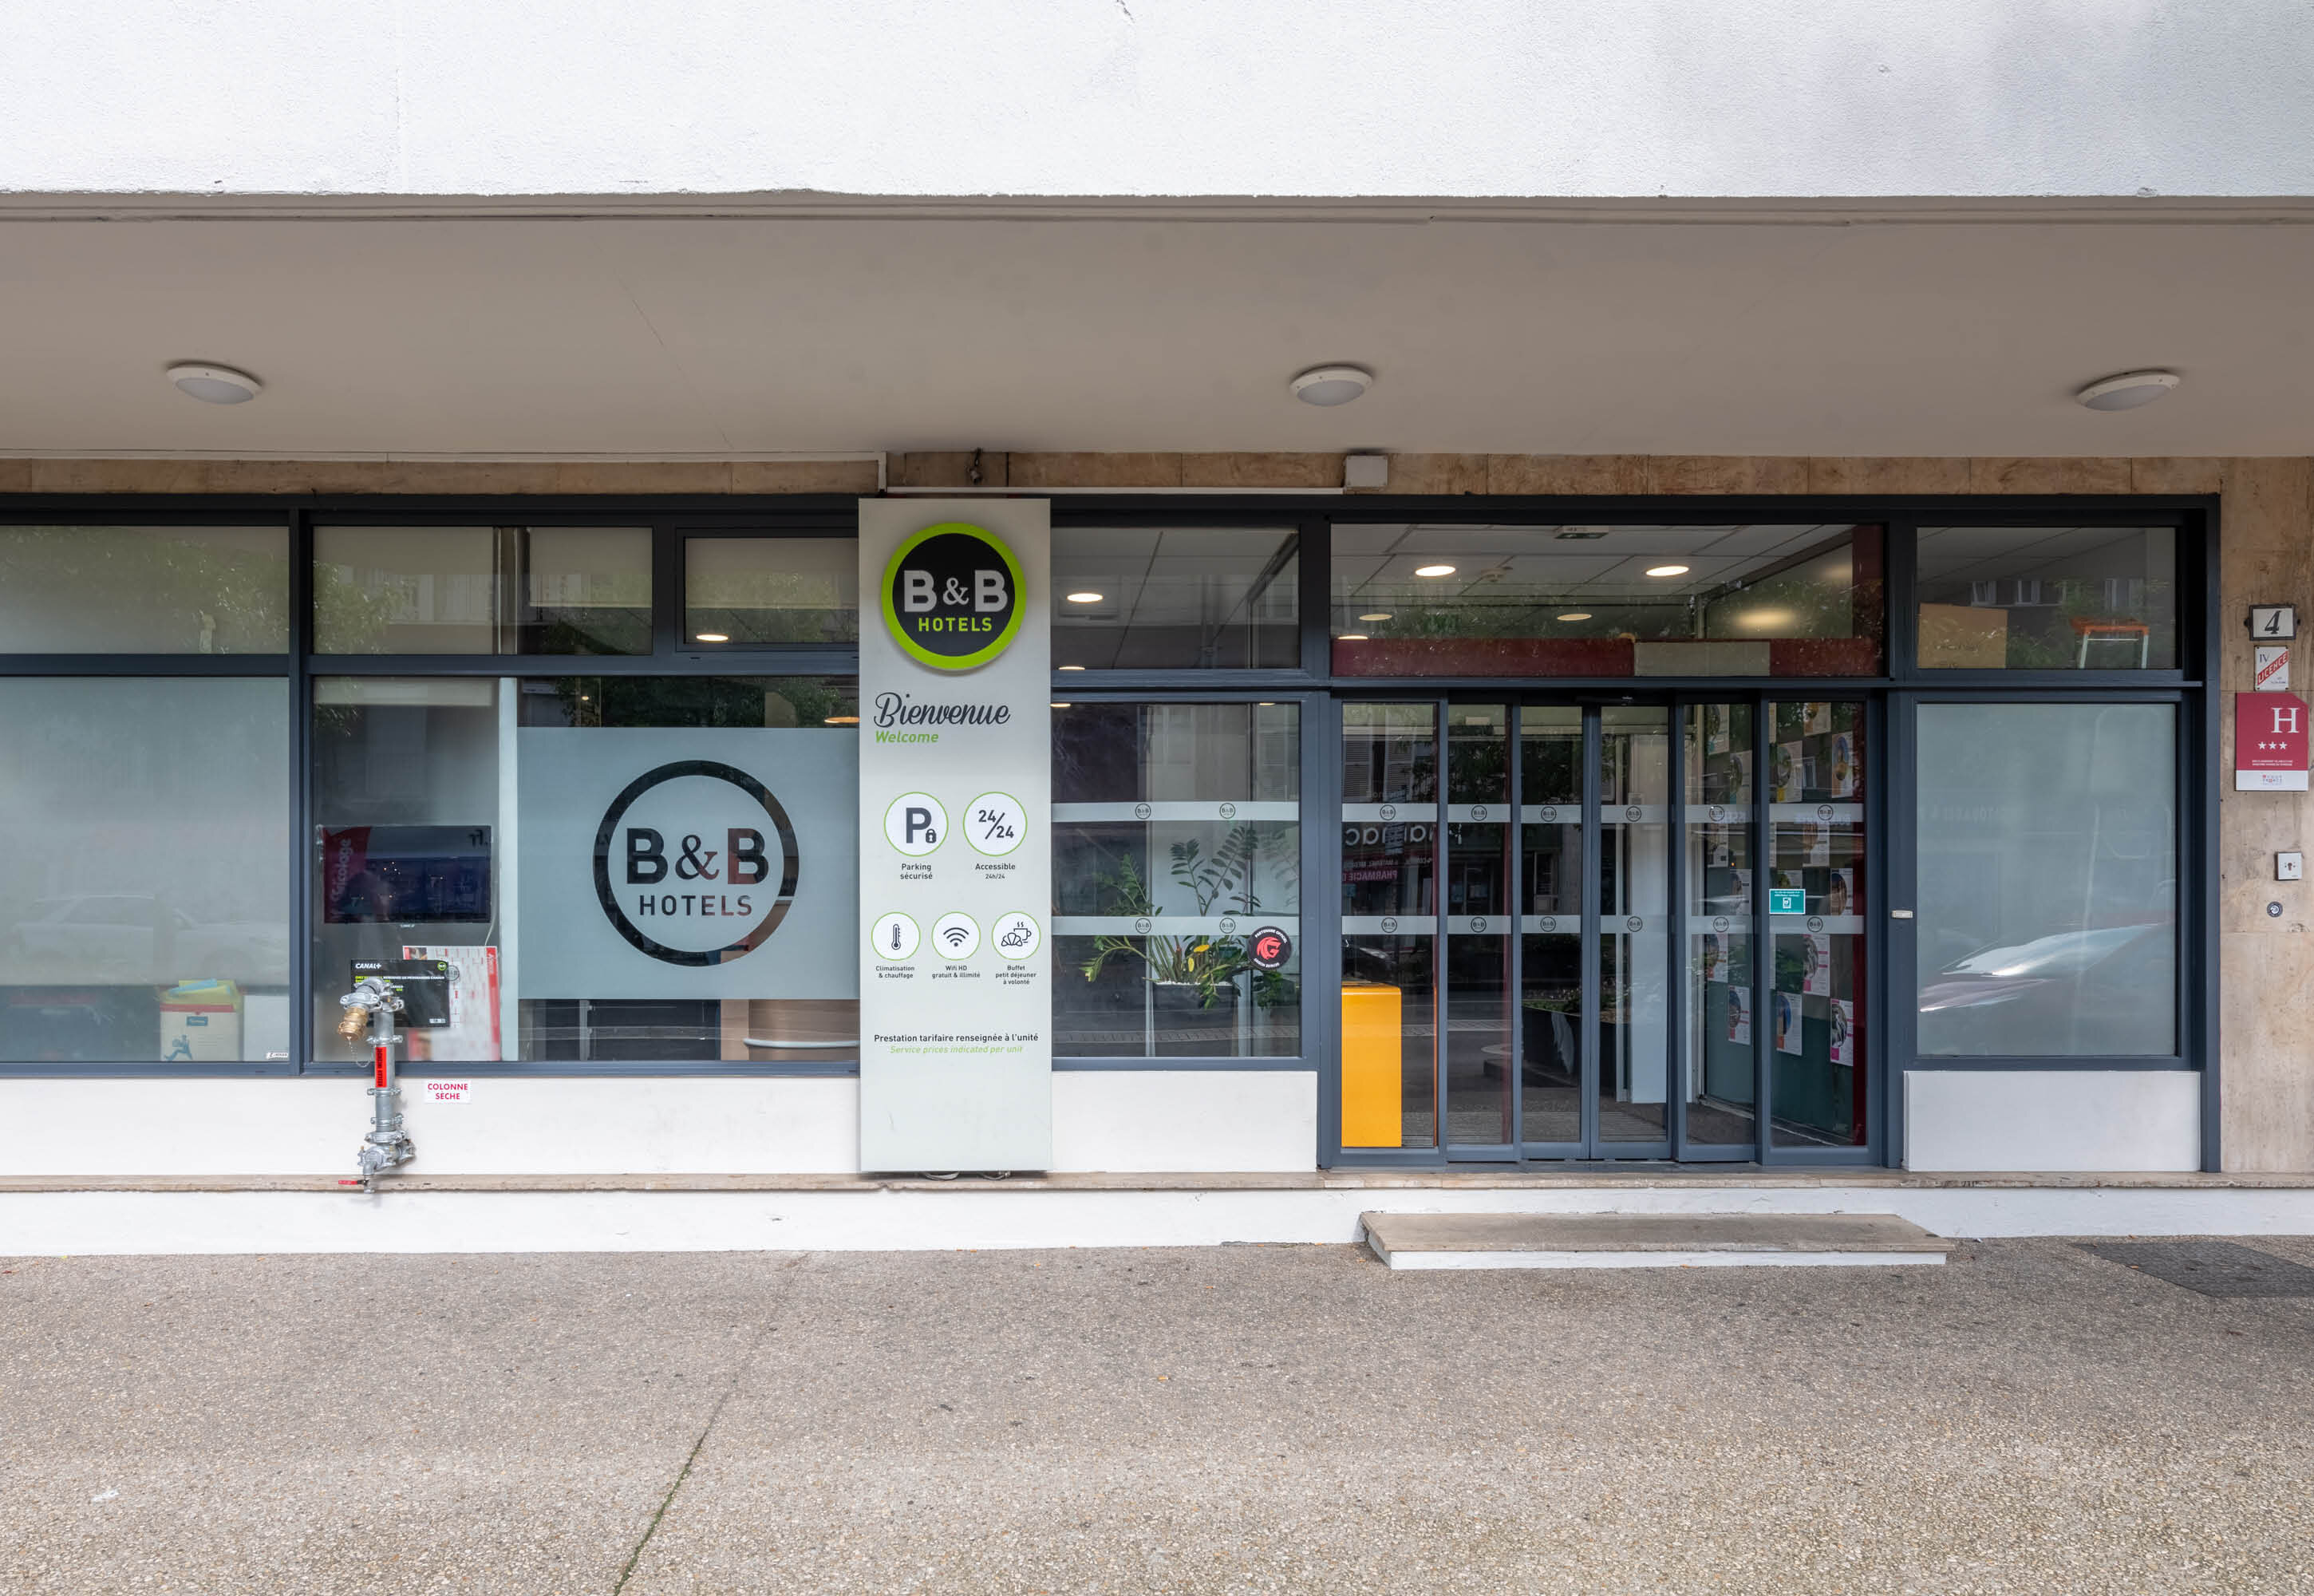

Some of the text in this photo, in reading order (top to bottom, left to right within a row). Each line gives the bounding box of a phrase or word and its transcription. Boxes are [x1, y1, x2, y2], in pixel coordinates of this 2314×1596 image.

[903, 569, 1008, 612] B&B
[918, 617, 992, 632] HOTELS
[2265, 610, 2282, 634] 4
[2258, 652, 2288, 683] LICENCE
[2259, 654, 2270, 663] IV
[874, 692, 1010, 728] Bienvenue
[2271, 707, 2300, 733] H
[875, 730, 939, 743] Welcome
[626, 828, 768, 884] B&B
[639, 895, 752, 916] HOTELS
[957, 1034, 1003, 1043] renseignée
[435, 1091, 460, 1100] SÈCHE
